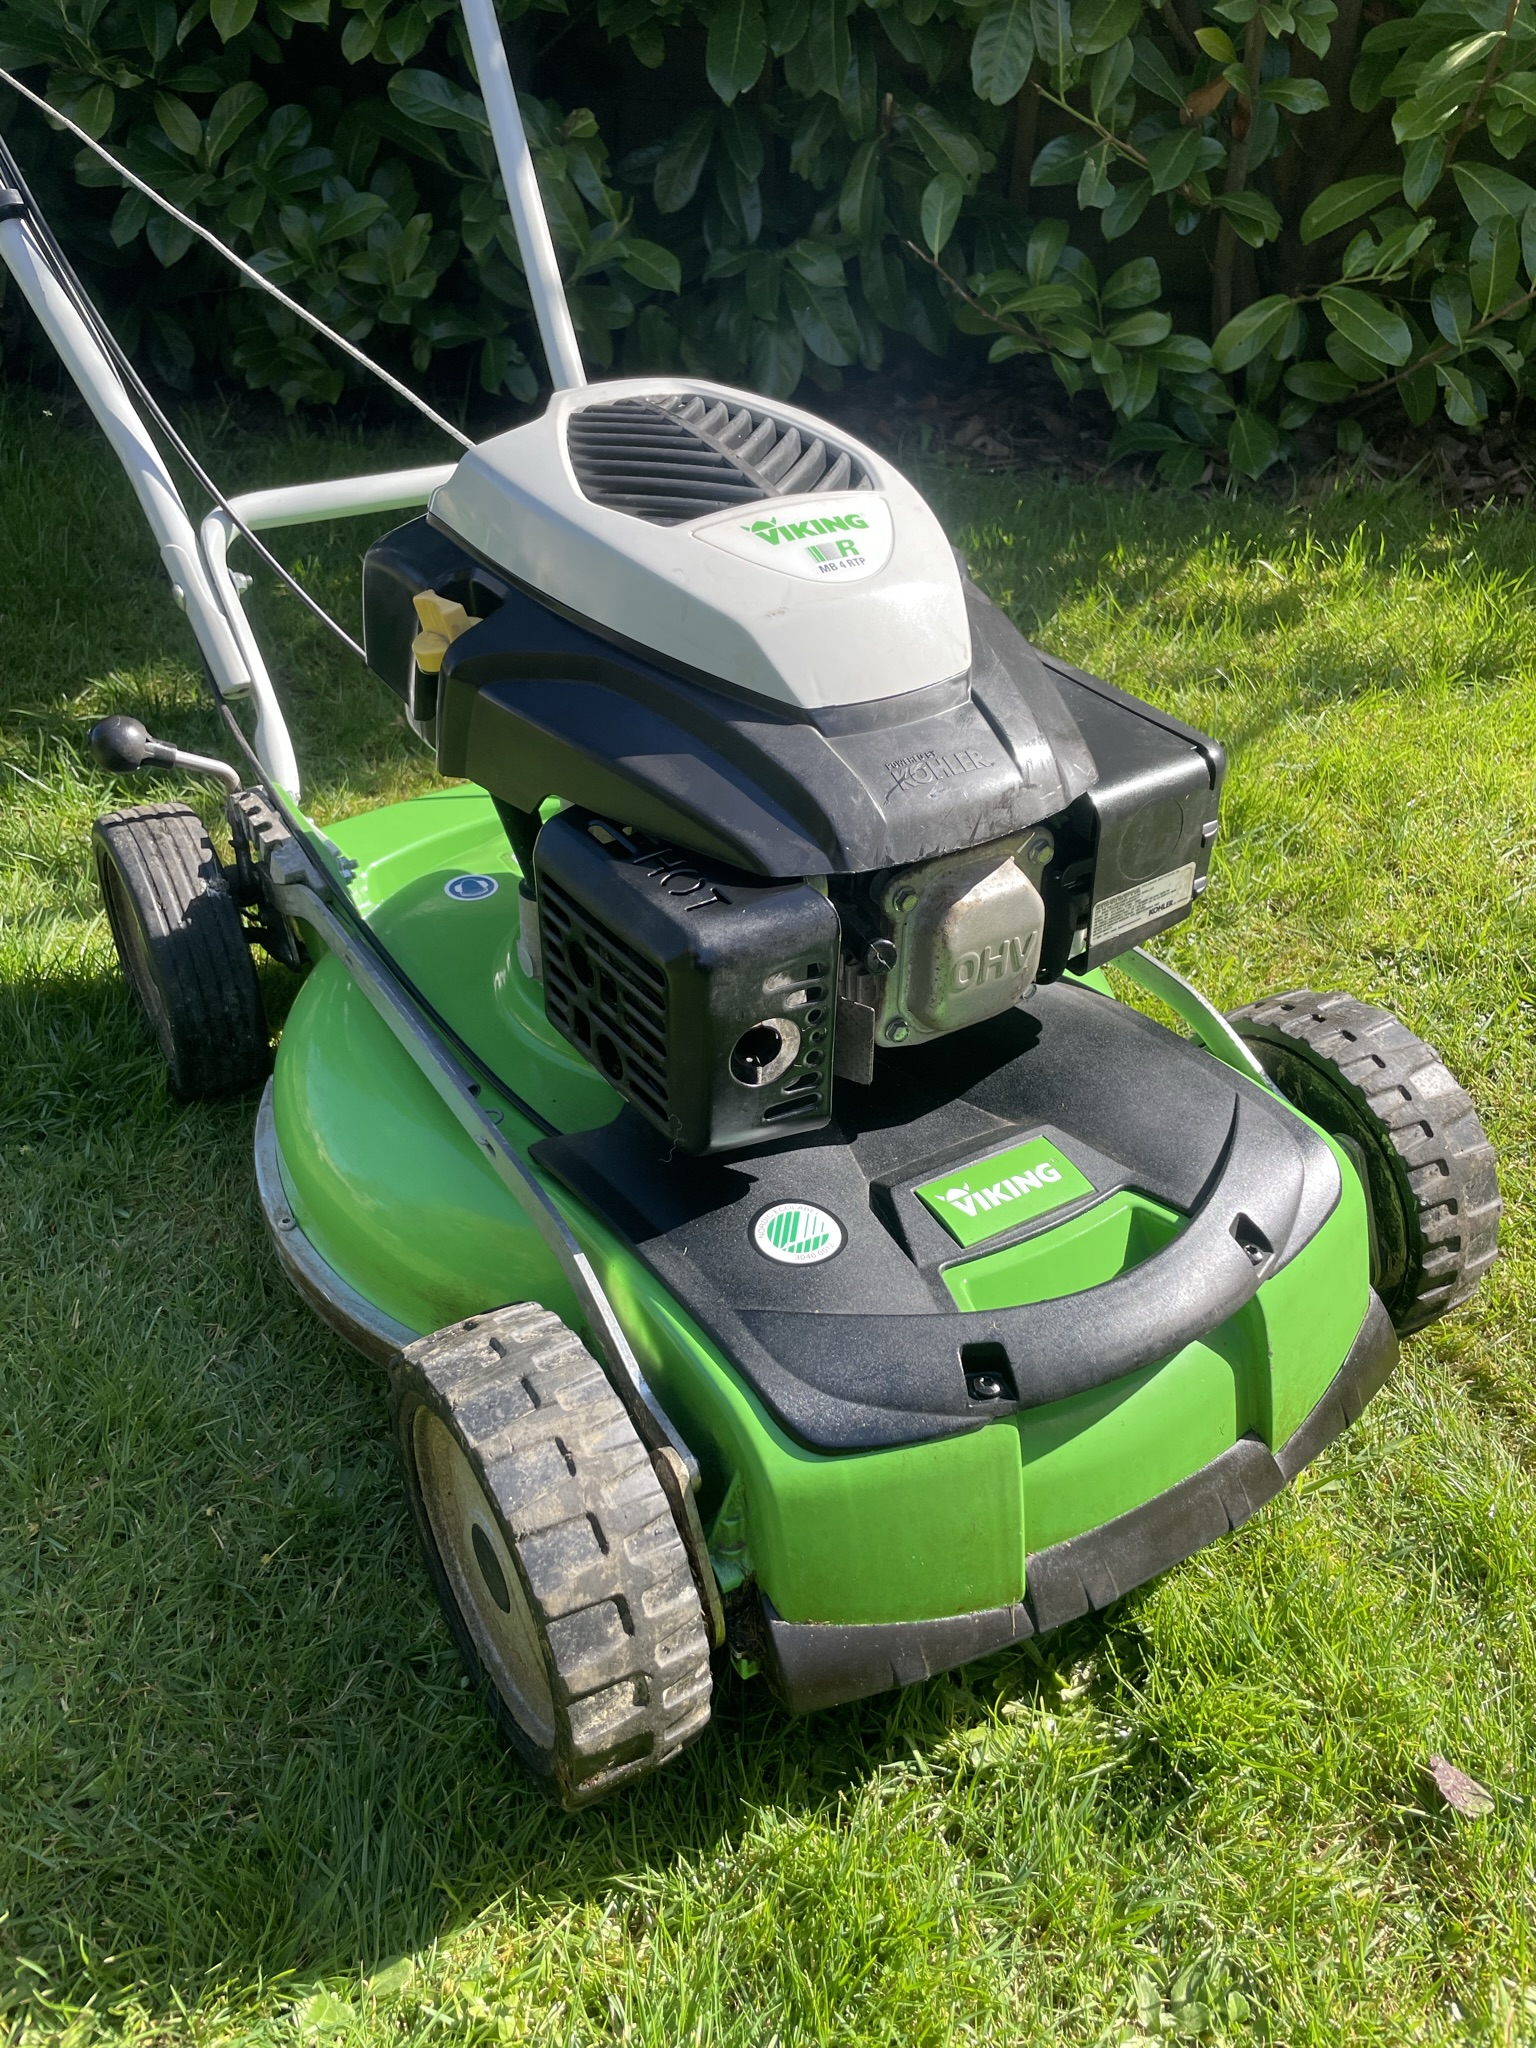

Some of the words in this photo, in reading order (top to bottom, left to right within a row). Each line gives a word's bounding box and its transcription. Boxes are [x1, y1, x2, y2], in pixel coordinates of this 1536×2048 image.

[754, 513, 870, 546] VIKING
[836, 539, 860, 558] R
[818, 561, 838, 574] MB
[839, 560, 846, 570] 4
[846, 557, 866, 568] RTP
[884, 754, 923, 771] POWERED
[885, 750, 995, 796] KOHLER
[633, 848, 732, 911] HOT
[1148, 900, 1174, 917] KOHLER
[952, 930, 1038, 993] OHV
[950, 1162, 1062, 1217] VIKING
[795, 1253, 817, 1261] 3040
